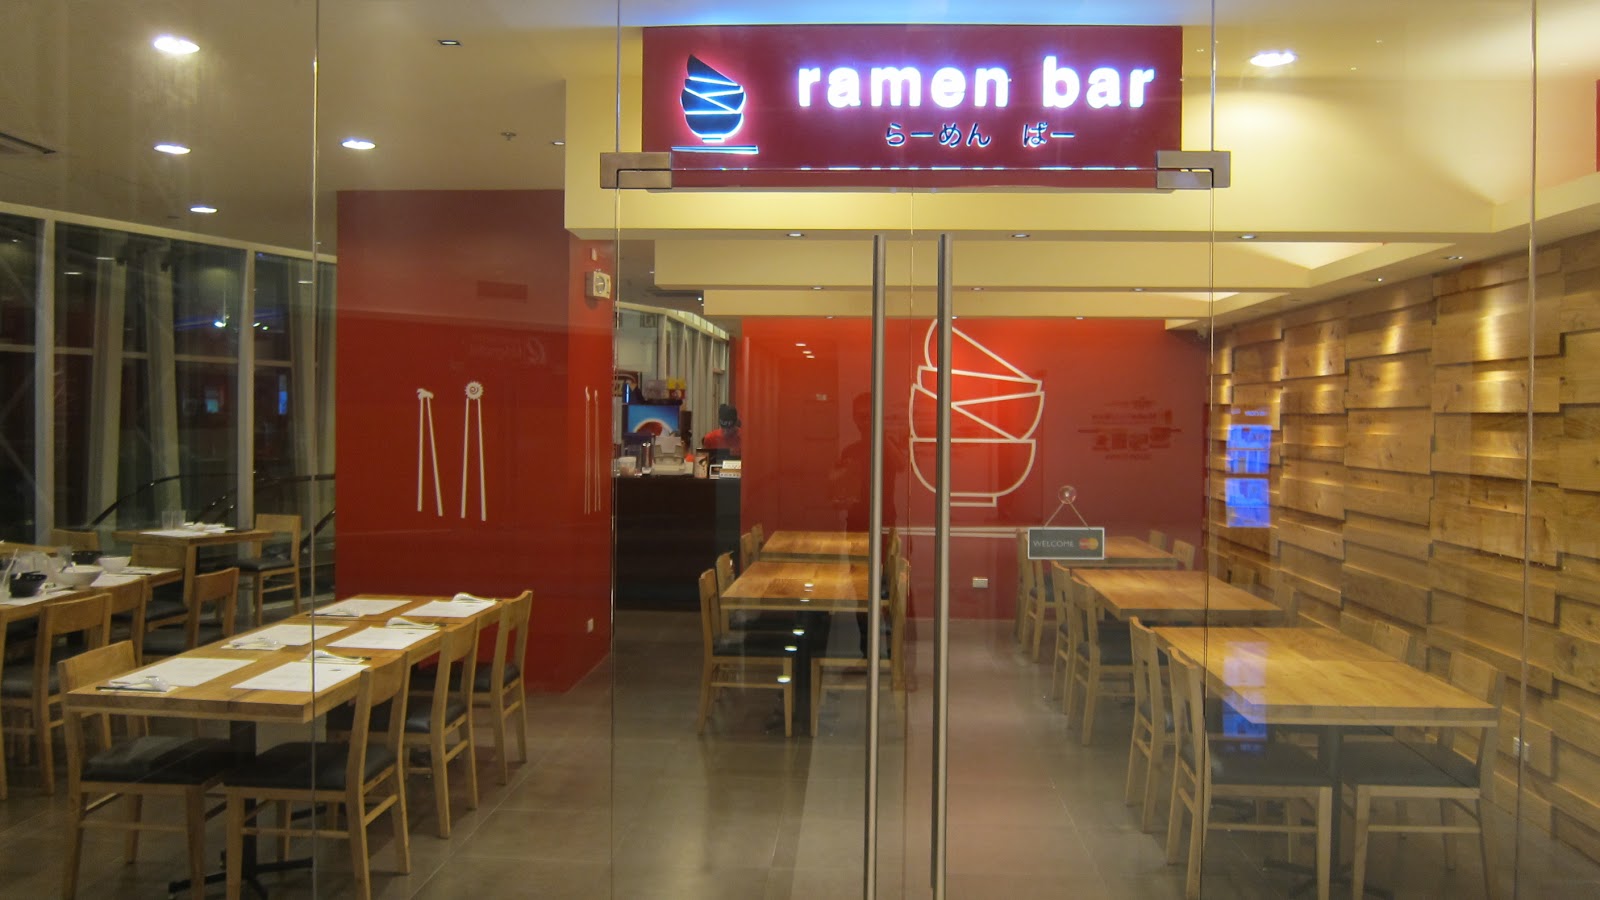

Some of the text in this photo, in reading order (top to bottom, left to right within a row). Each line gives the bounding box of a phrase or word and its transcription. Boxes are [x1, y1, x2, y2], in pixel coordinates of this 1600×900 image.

[798, 55, 1155, 109] ramen bar
[885, 121, 1076, 148] らーめん ばー
